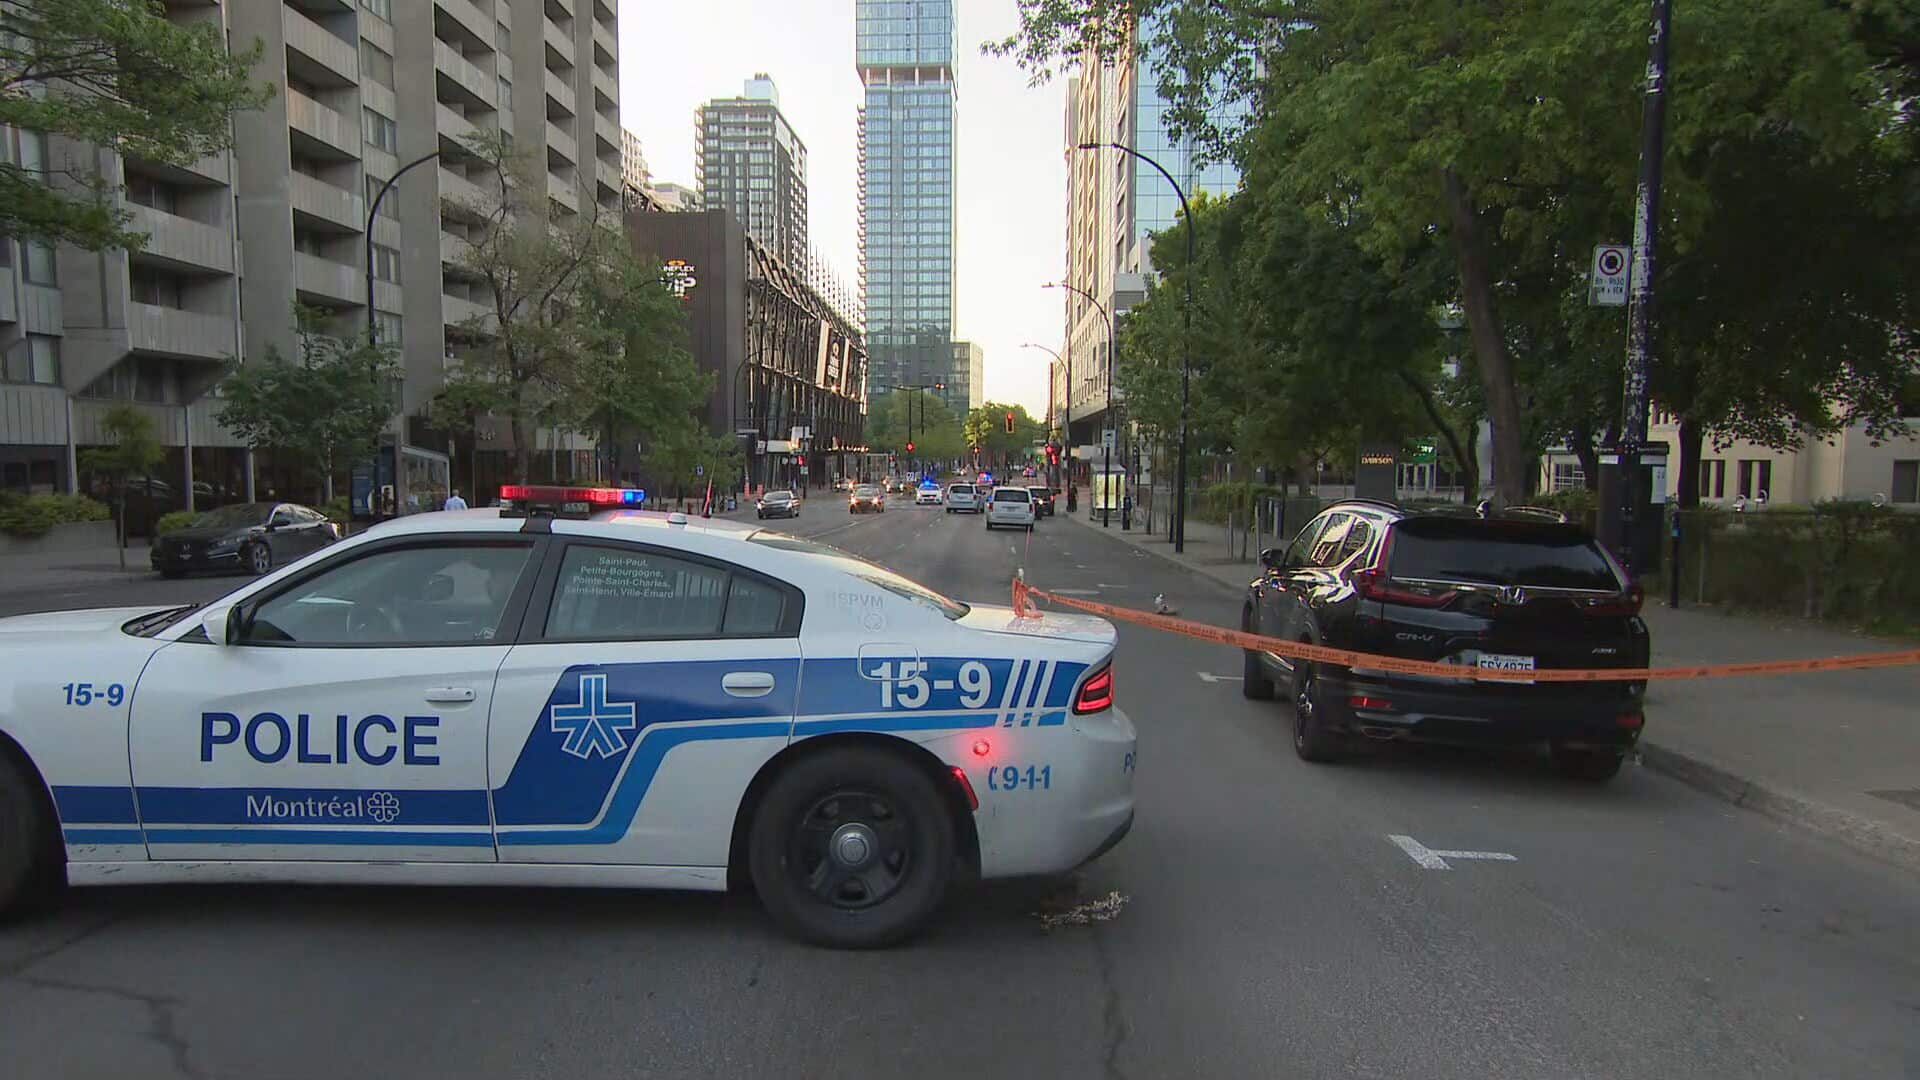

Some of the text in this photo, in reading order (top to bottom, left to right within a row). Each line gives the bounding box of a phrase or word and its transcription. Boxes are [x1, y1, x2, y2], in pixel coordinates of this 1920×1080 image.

[573, 576, 671, 588] Pointe-Saint-Charles,
[581, 566, 664, 578] Petite-Bourgogne,
[1395, 632, 1434, 641] CR-V
[62, 683, 125, 706] 15-9
[871, 661, 992, 709] 15-9
[200, 712, 440, 766] POLICE
[1003, 765, 1051, 791] 9-1-1
[246, 795, 364, 818] Montréal
